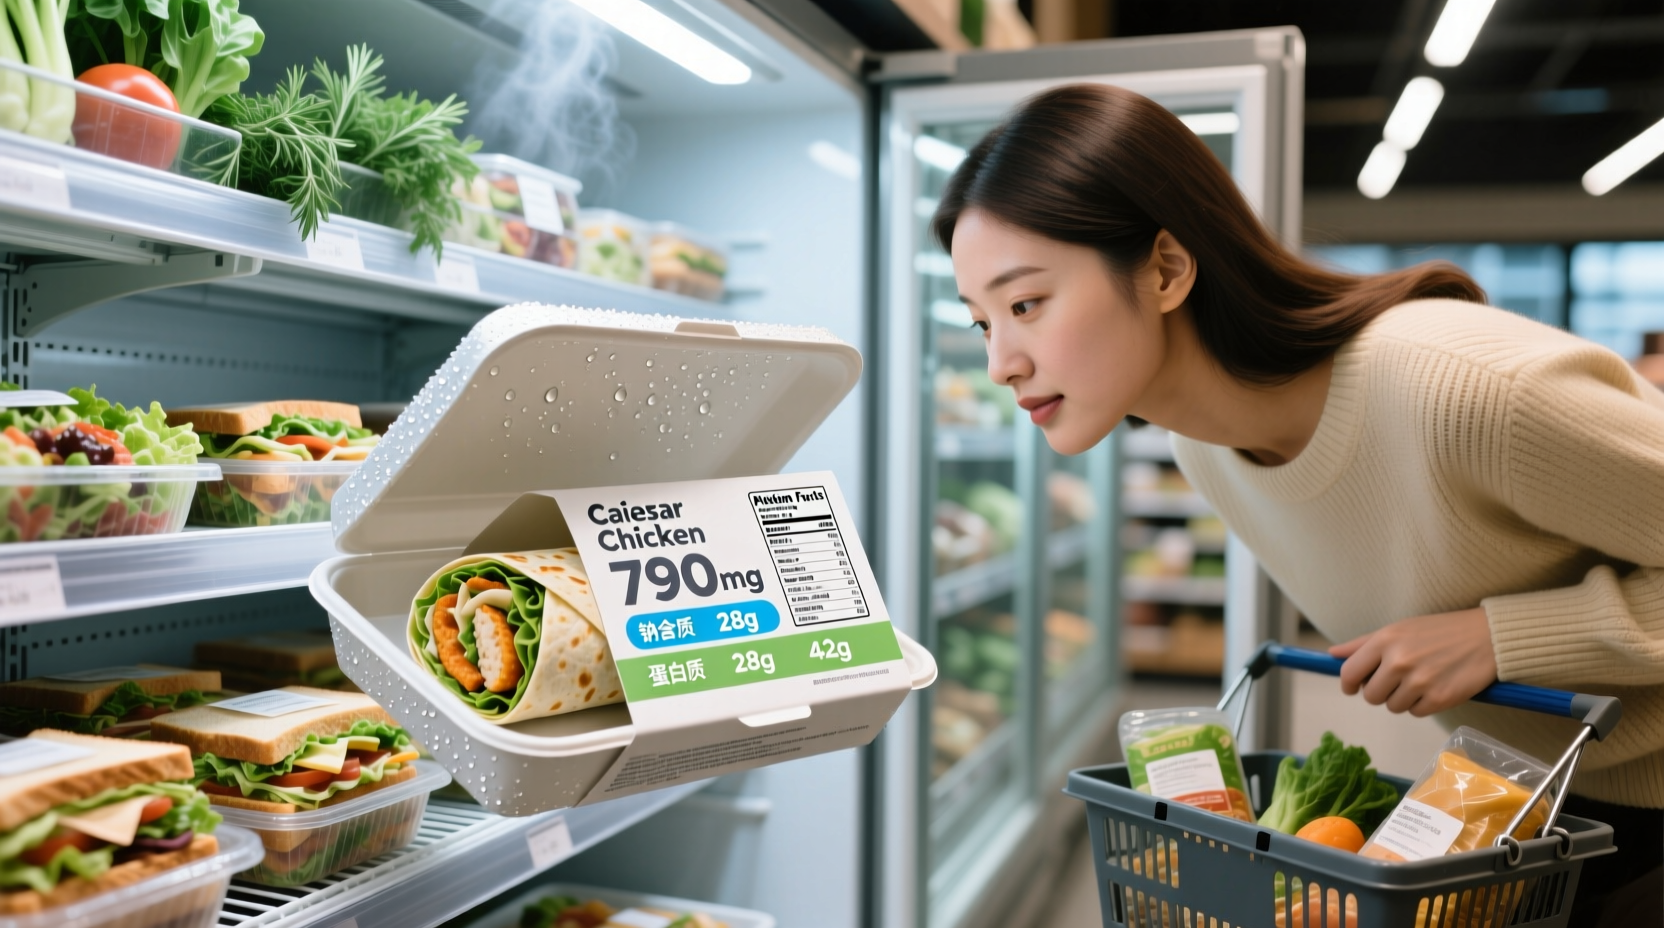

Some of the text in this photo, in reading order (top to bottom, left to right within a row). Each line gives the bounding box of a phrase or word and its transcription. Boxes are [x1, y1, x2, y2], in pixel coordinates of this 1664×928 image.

[588, 501, 683, 526] Caiesar
[598, 524, 706, 552] Chicken
[716, 610, 759, 633] 28g
[648, 638, 852, 687] 蛋白质 28g 42g
